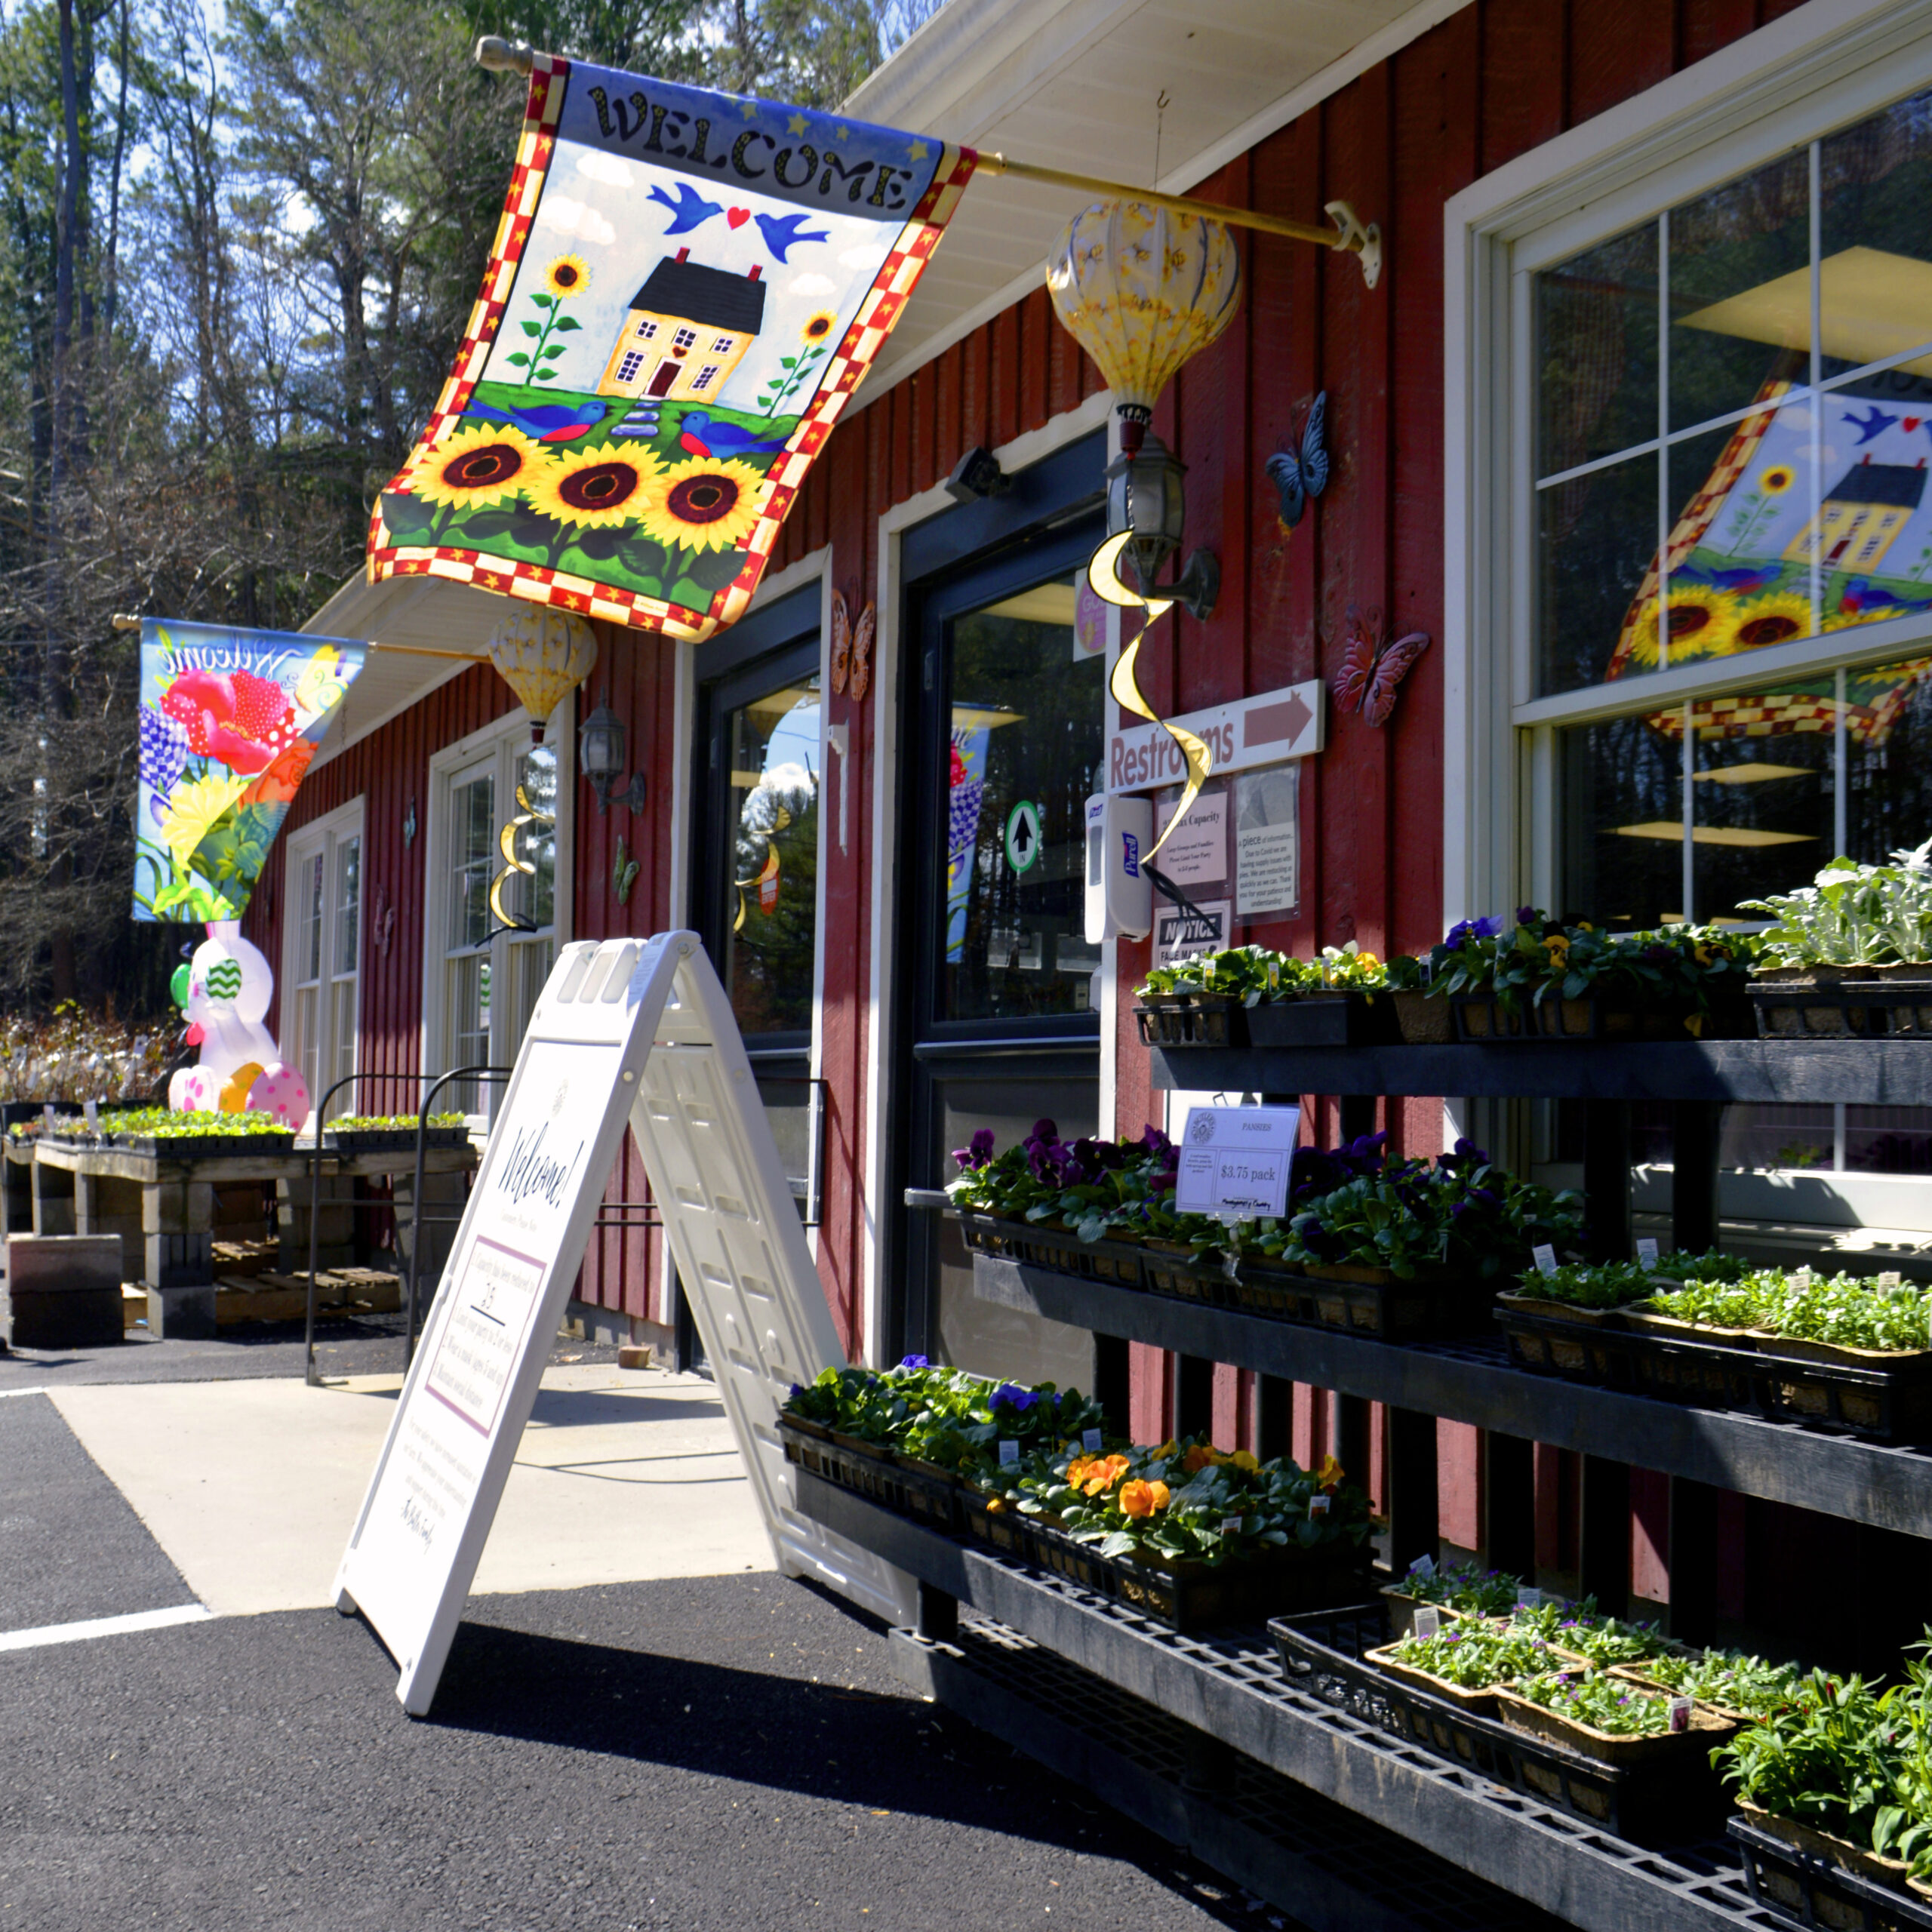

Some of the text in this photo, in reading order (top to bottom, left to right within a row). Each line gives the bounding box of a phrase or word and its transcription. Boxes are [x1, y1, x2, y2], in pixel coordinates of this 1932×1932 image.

[588, 86, 912, 210] WELCOME
[1111, 723, 1233, 788] Restroms
[1189, 811, 1220, 826] Capacity
[1125, 837, 1136, 872] Purell
[1242, 835, 1261, 848] piece
[1241, 1123, 1272, 1131] PANSIES
[498, 1121, 584, 1209] Welcome!
[1221, 1165, 1275, 1183] $3.75 pack
